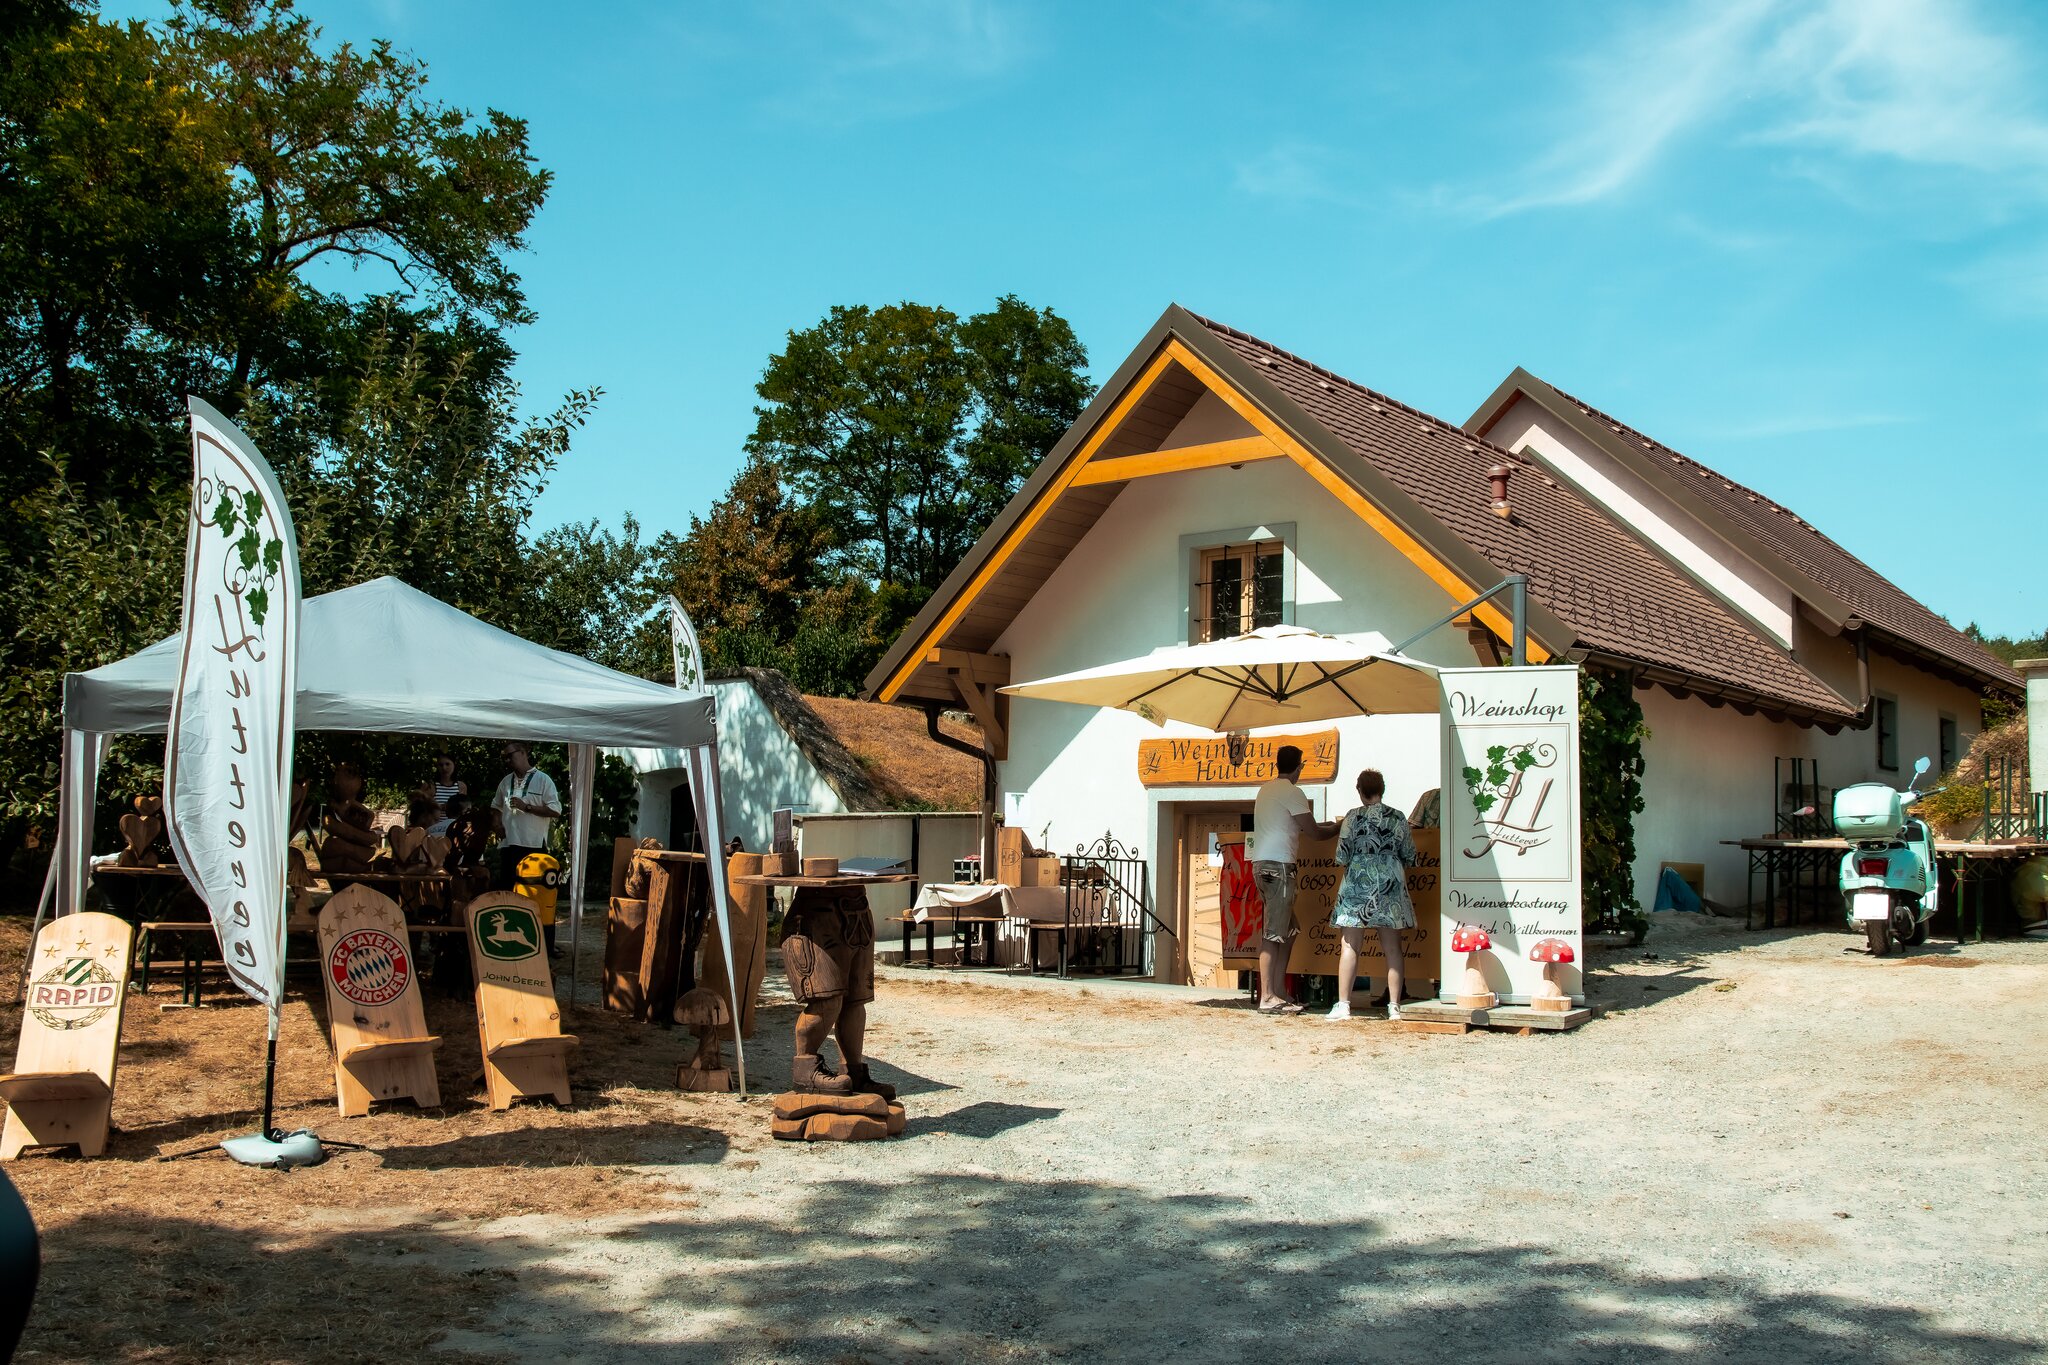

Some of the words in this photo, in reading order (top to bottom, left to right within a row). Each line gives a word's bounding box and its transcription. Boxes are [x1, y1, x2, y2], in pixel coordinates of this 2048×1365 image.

[1450, 688, 1567, 722] Weinshop
[1169, 739, 1273, 761] Weinbau
[1196, 759, 1307, 782] Hutter
[1301, 874, 1336, 891] 0699
[1449, 889, 1570, 914] Weinverkostung
[1503, 921, 1579, 936] Willkommen
[333, 947, 349, 967] FC
[348, 933, 402, 960] BAYERN
[1314, 943, 1342, 956] 2472
[339, 971, 406, 1002] MÜNCHEN
[483, 971, 511, 982] JOHN
[512, 975, 549, 988] DEERE
[36, 986, 114, 1006] RAPID
